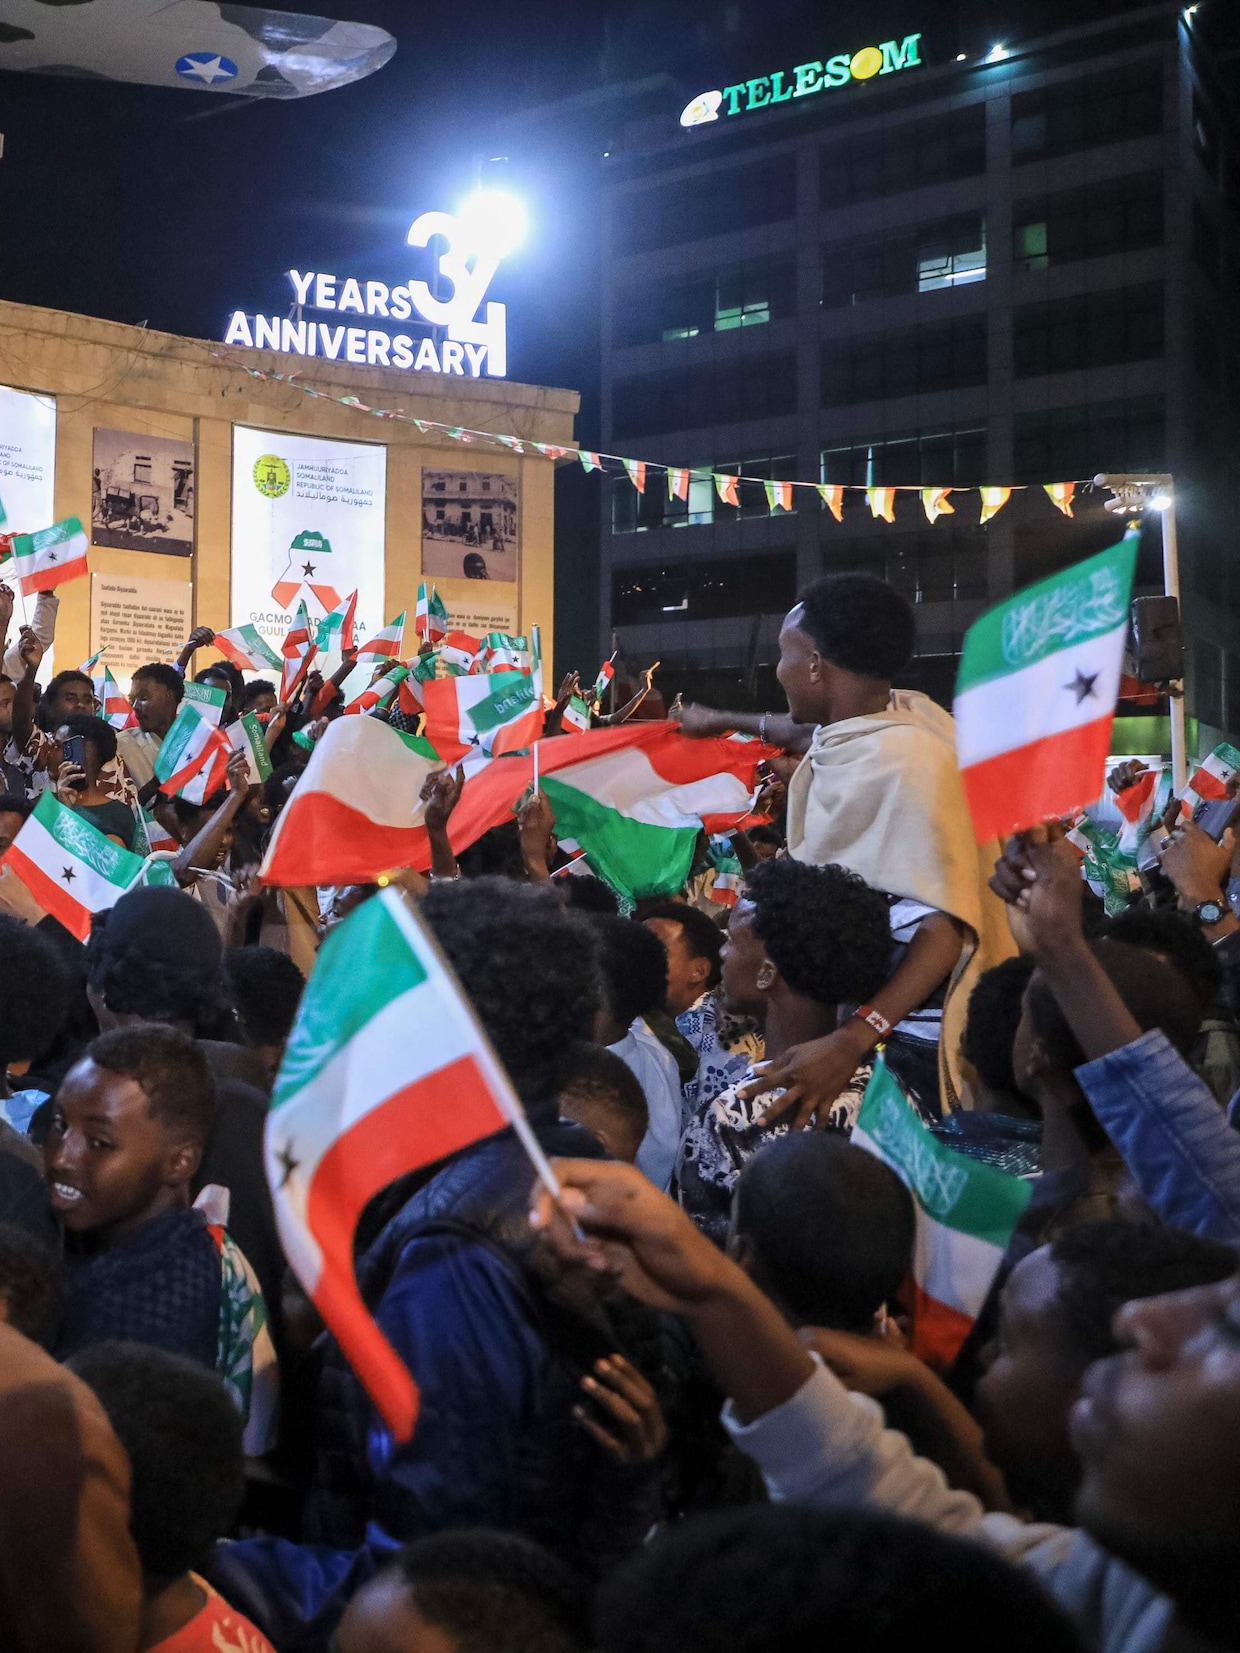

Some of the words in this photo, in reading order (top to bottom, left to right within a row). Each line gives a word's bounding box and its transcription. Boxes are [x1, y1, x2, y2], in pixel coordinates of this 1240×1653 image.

[723, 33, 922, 116] TELESOM
[288, 268, 411, 320] YEARS
[224, 310, 488, 378] ANNIVERSARY
[296, 463, 349, 475] JAMHUURIYADDA
[296, 472, 335, 483] SOMALILAND
[296, 481, 325, 490] REPUBLIC
[335, 486, 374, 496] SOMALILAND
[250, 612, 292, 625] GACMO
[258, 626, 286, 637] GUUL
[249, 724, 269, 767] Somaliland
